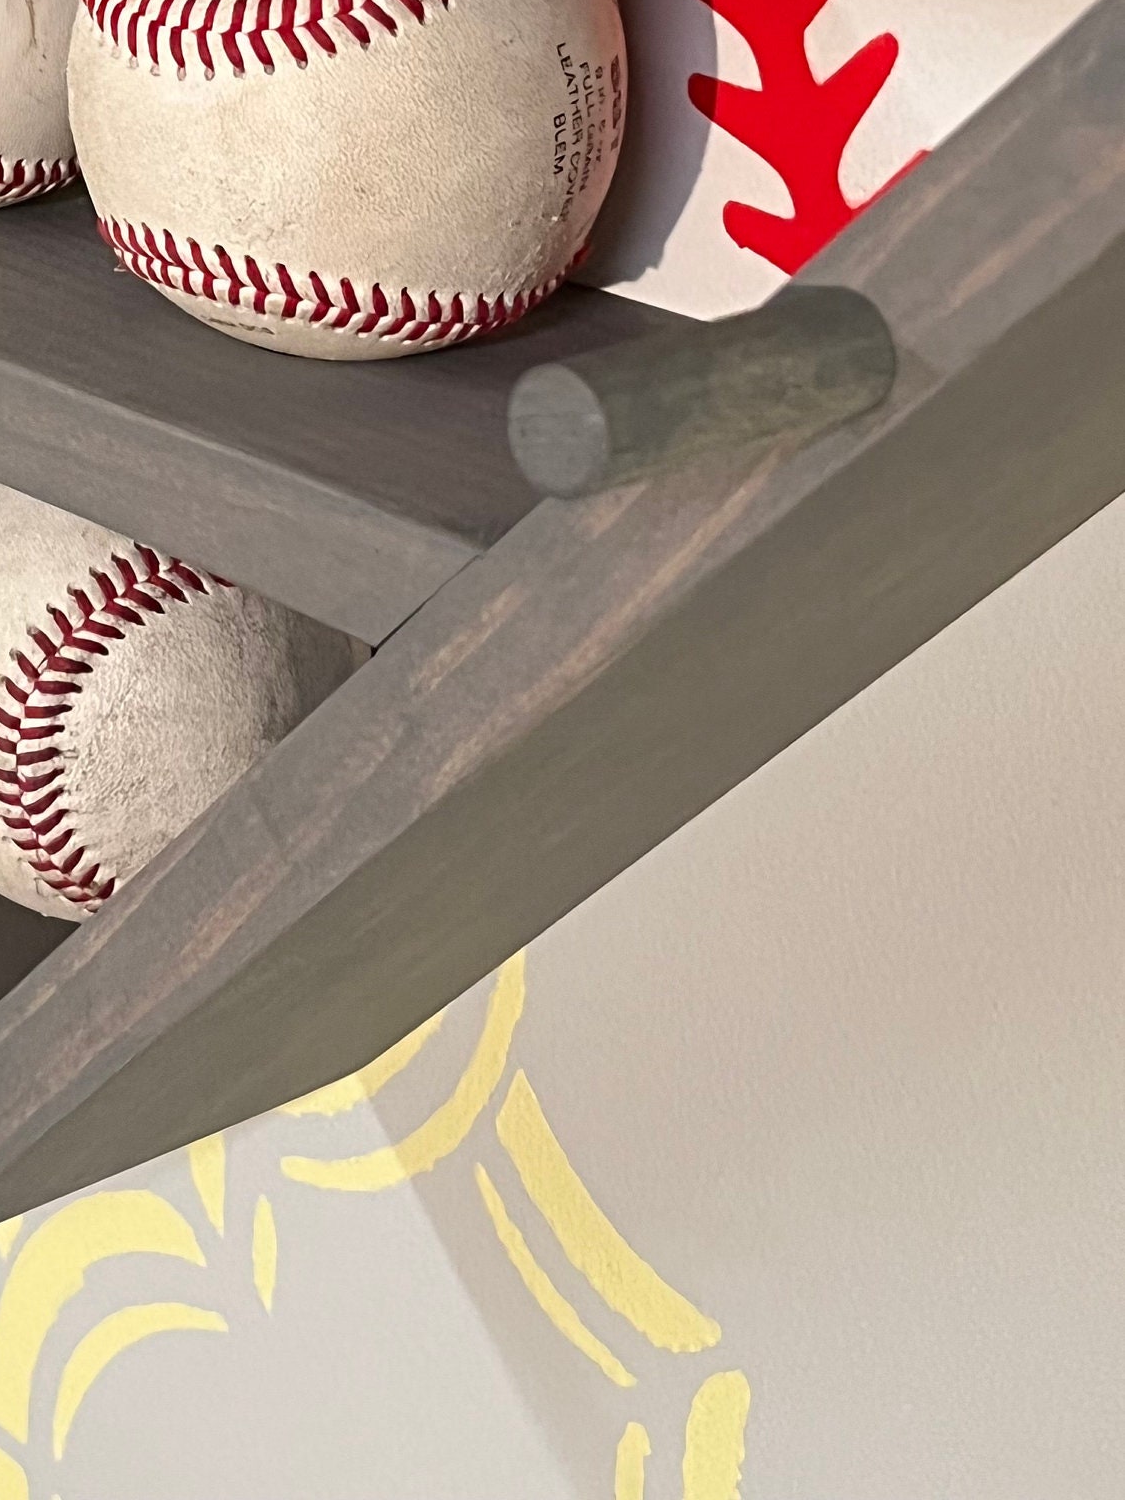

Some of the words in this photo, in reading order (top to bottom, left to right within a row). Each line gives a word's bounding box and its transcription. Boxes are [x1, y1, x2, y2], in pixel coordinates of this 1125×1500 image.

[556, 42, 584, 146] LEATHER
[579, 61, 596, 117] FULL
[553, 112, 567, 175] BLEM
